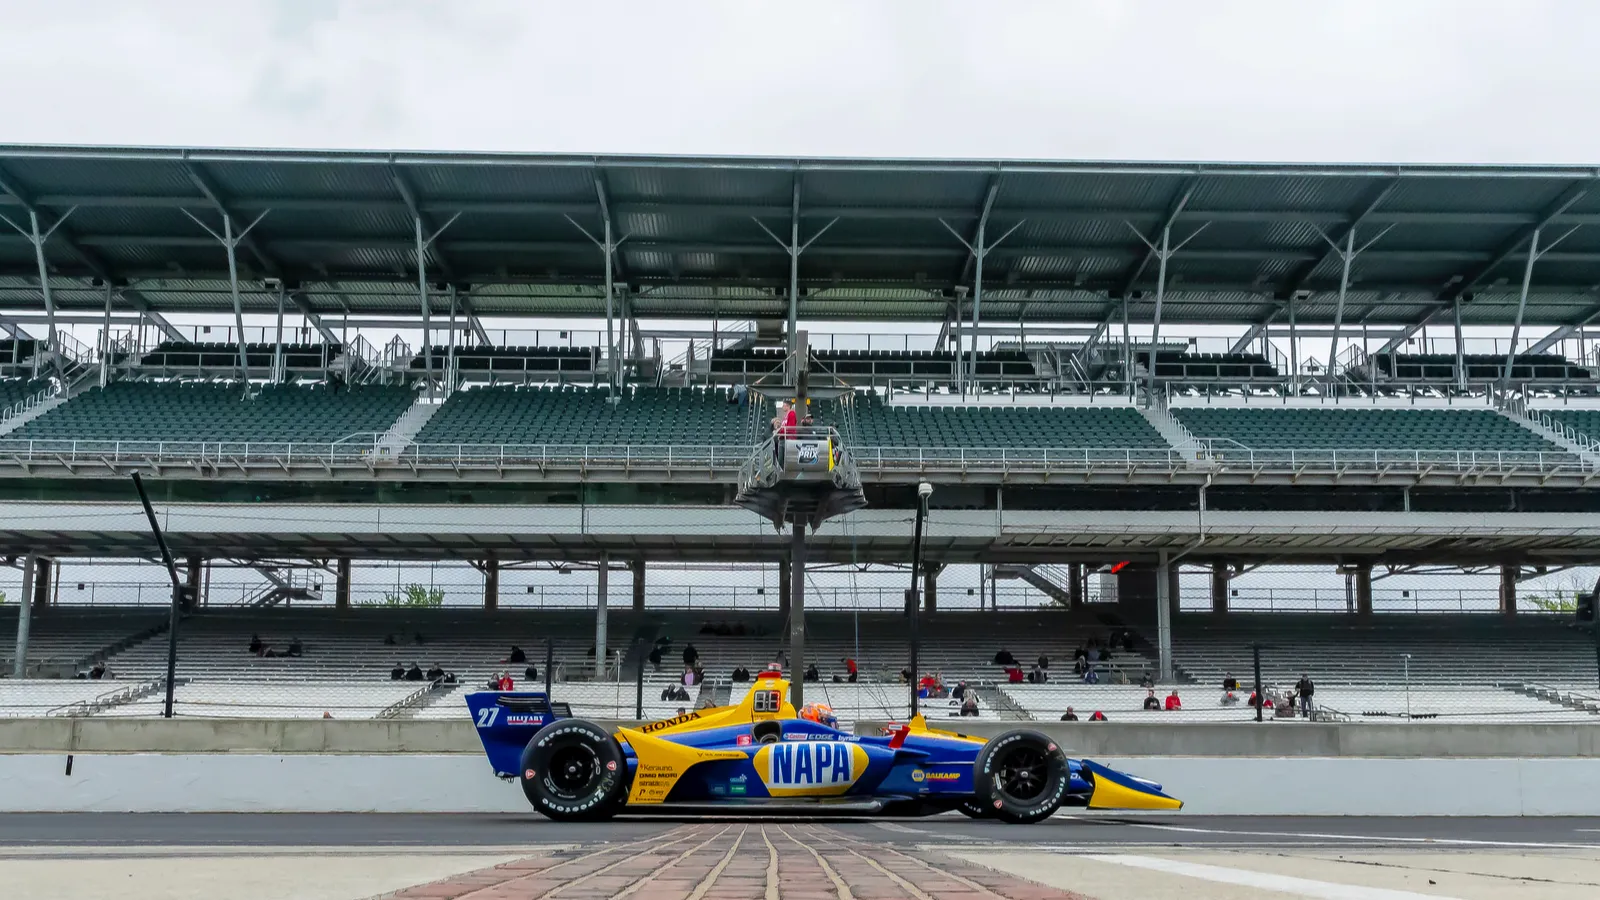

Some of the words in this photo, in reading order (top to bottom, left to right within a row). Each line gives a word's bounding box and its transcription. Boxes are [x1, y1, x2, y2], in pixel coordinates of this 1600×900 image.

[799, 450, 818, 458] PRIX
[477, 707, 499, 727] 27
[642, 711, 701, 733] HONDA
[538, 727, 601, 747] Firestone
[773, 743, 850, 784] NAPA
[984, 735, 1021, 773] Firestone
[542, 788, 604, 813] Firestone
[1030, 777, 1065, 815] Firestone
